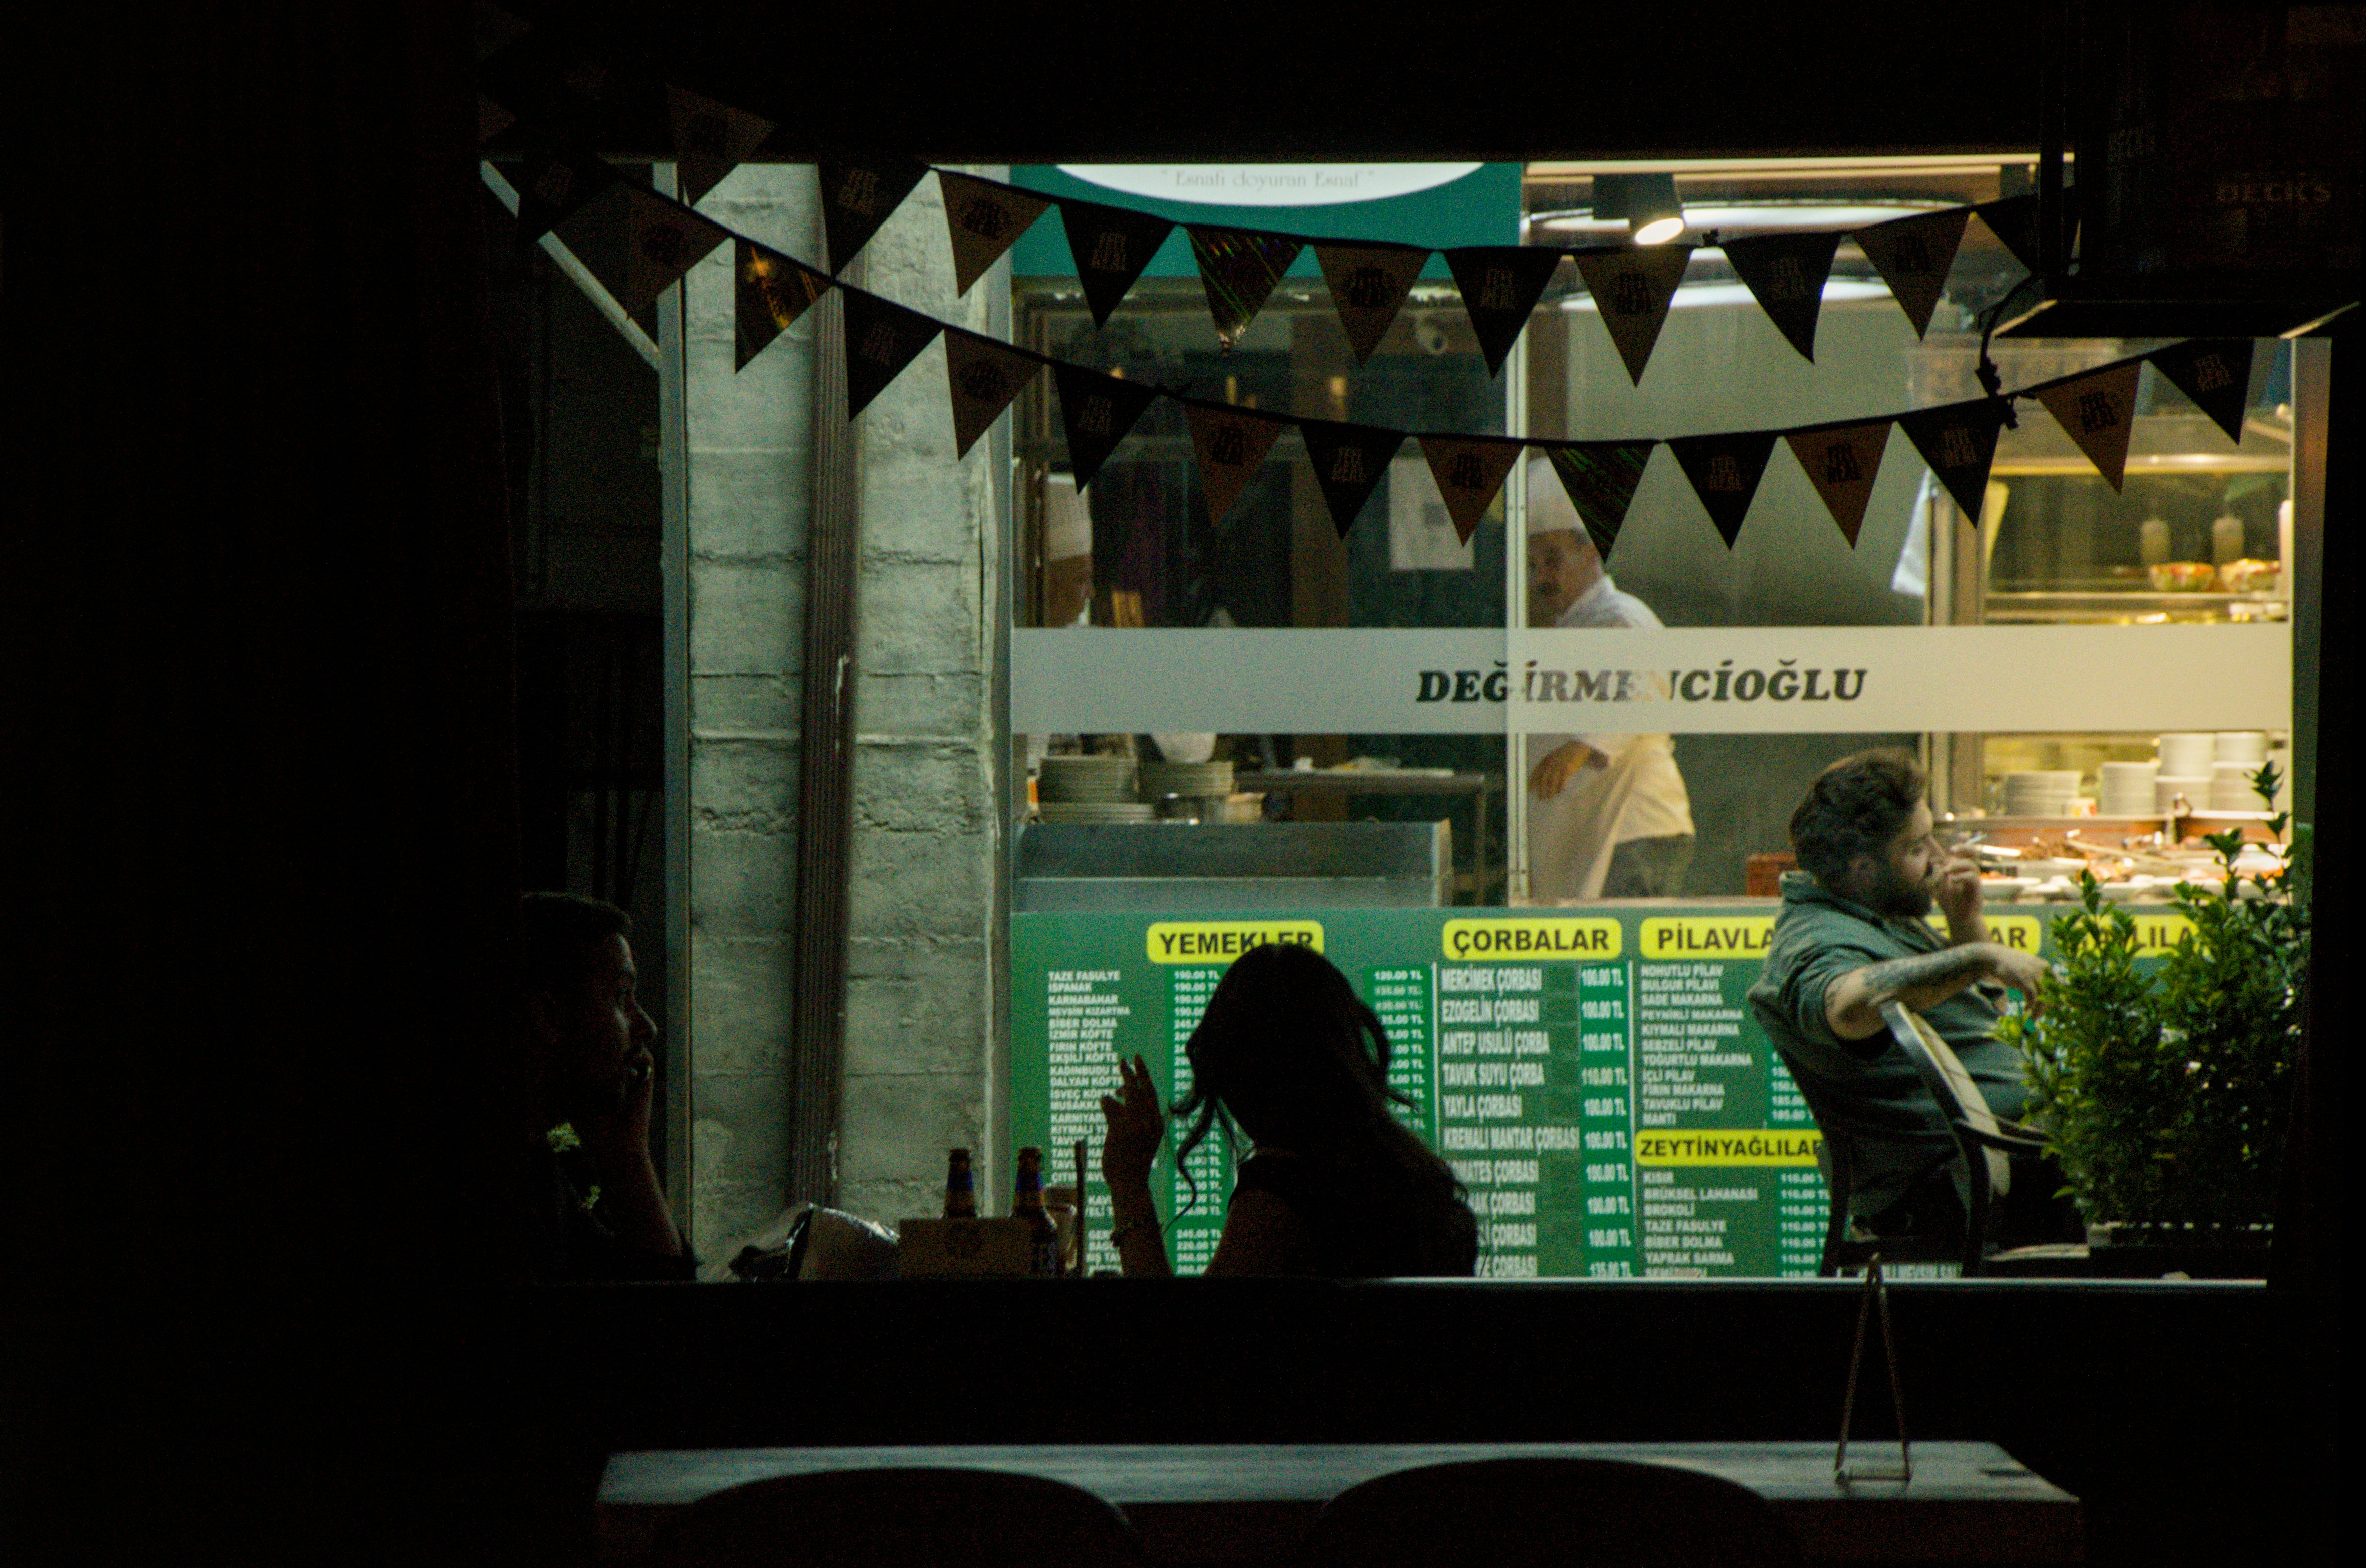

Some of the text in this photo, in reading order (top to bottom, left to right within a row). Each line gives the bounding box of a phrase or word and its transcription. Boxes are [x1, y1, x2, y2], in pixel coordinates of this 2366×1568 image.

[1232, 170, 1306, 192] doyuran
[1453, 929, 1609, 957] ÇORBALAR
[1658, 923, 1774, 950] PİLAVLA
[1410, 970, 1423, 980] TL
[1611, 968, 1624, 986] TL
[1612, 1000, 1624, 1019] TL
[1411, 1014, 1424, 1025] TL
[1411, 1029, 1424, 1040] TL
[1613, 1033, 1625, 1051] TL
[1411, 1044, 1424, 1055] TL
[1442, 1031, 1476, 1055] ANTEP
[1515, 1031, 1550, 1059] ÇORBA
[1411, 1059, 1425, 1069] TL
[1412, 1073, 1425, 1084] TL
[1510, 1063, 1545, 1091] ÇORBA
[1615, 1067, 1627, 1085] TL
[1443, 1095, 1476, 1118] YAYLA
[1614, 1098, 1627, 1116] TL
[1615, 1130, 1627, 1149] TL
[1616, 1163, 1629, 1182] TL
[1618, 1196, 1630, 1214] TL
[1619, 1228, 1631, 1247] TL
